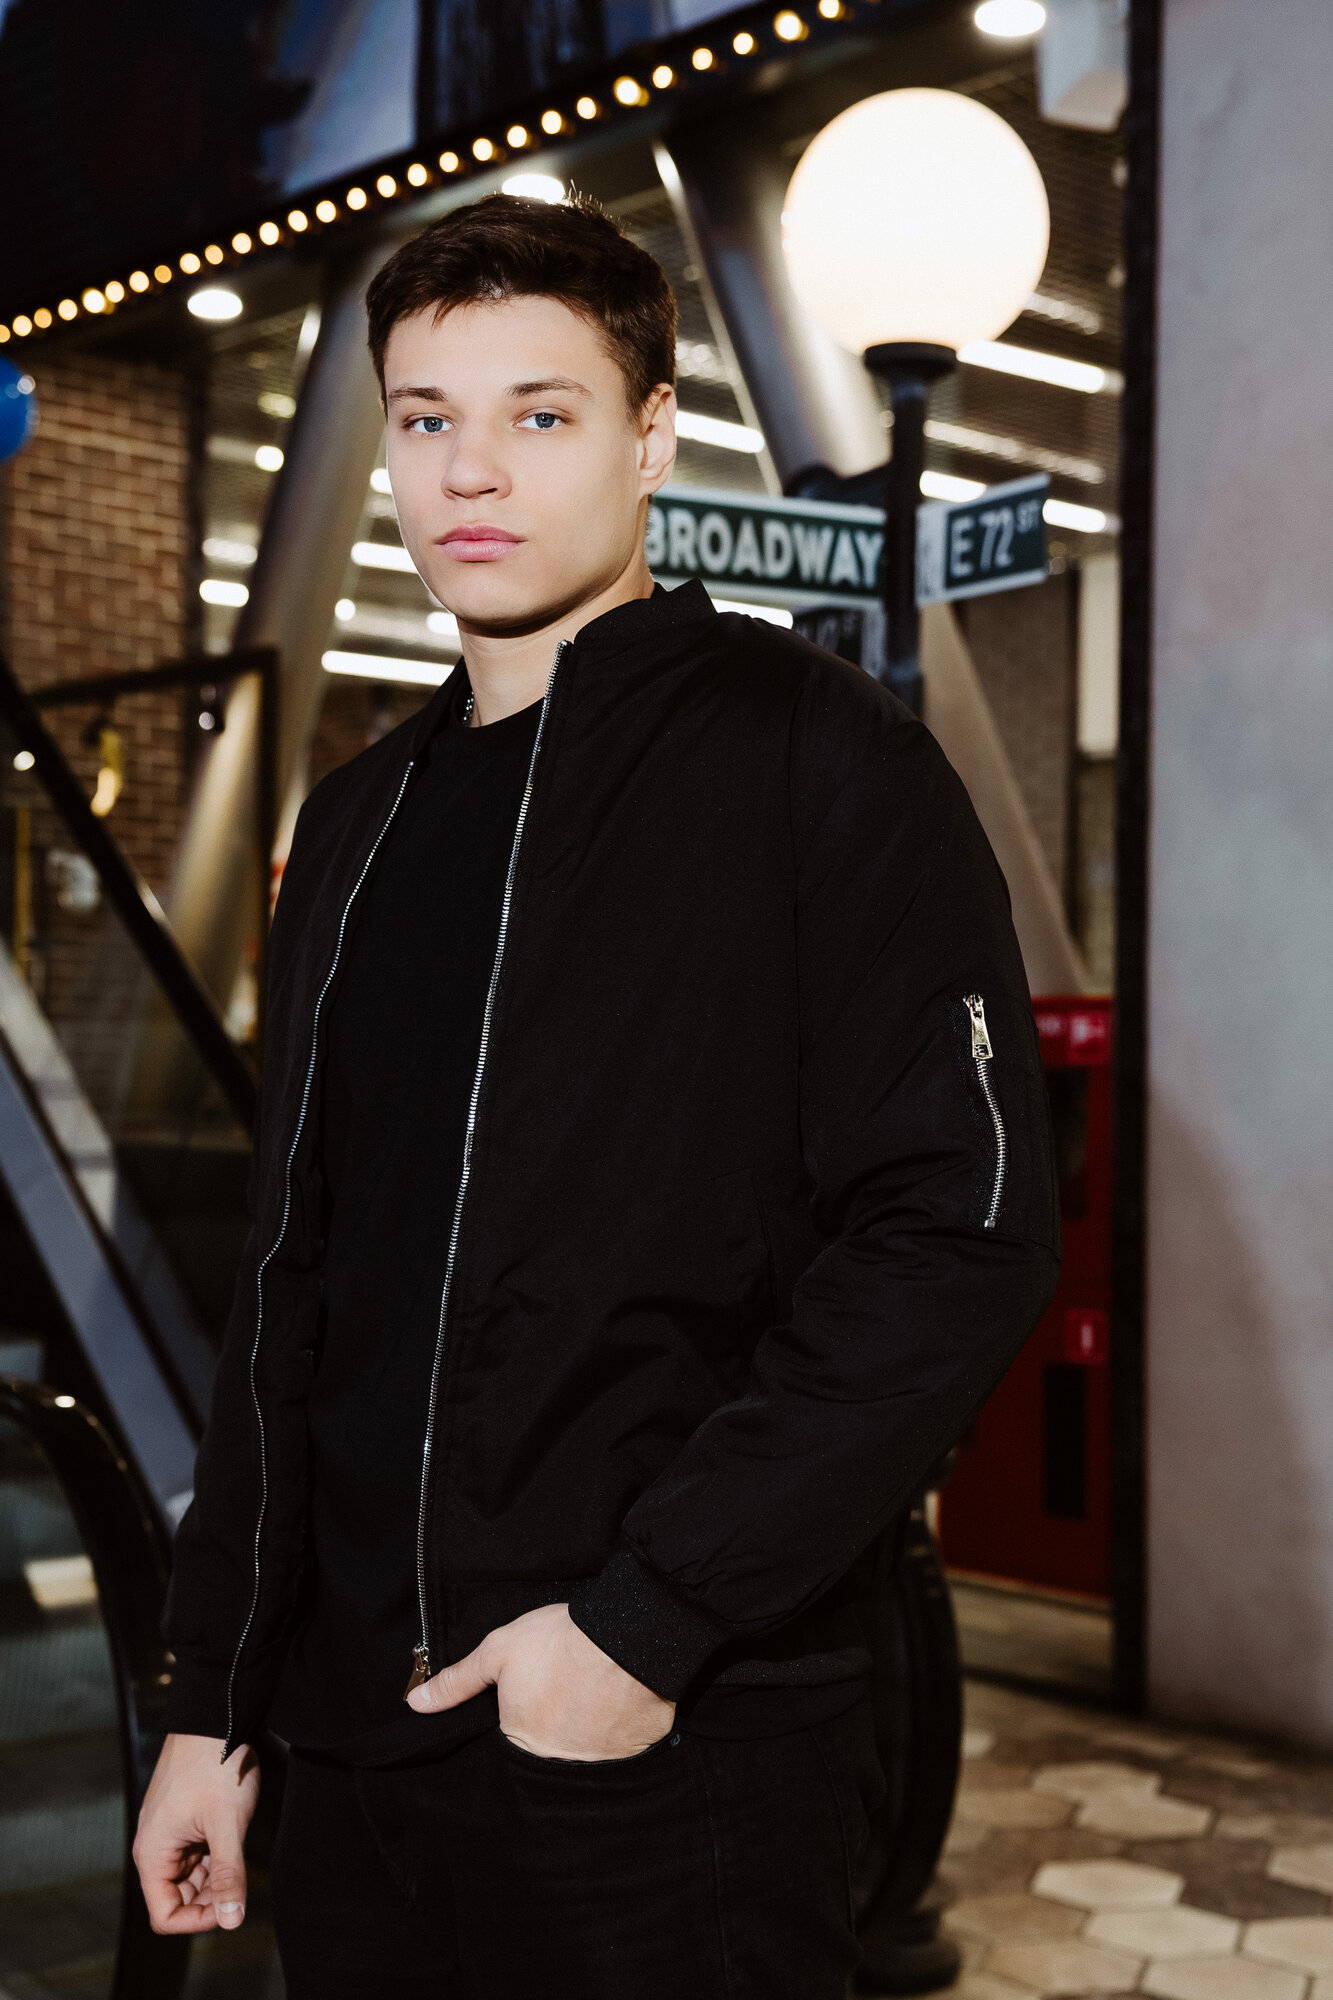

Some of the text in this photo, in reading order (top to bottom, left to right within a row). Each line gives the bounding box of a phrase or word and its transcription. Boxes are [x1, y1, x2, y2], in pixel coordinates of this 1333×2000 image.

[645, 505, 884, 587] BROADWAY
[950, 499, 1041, 578] E 72 ST
